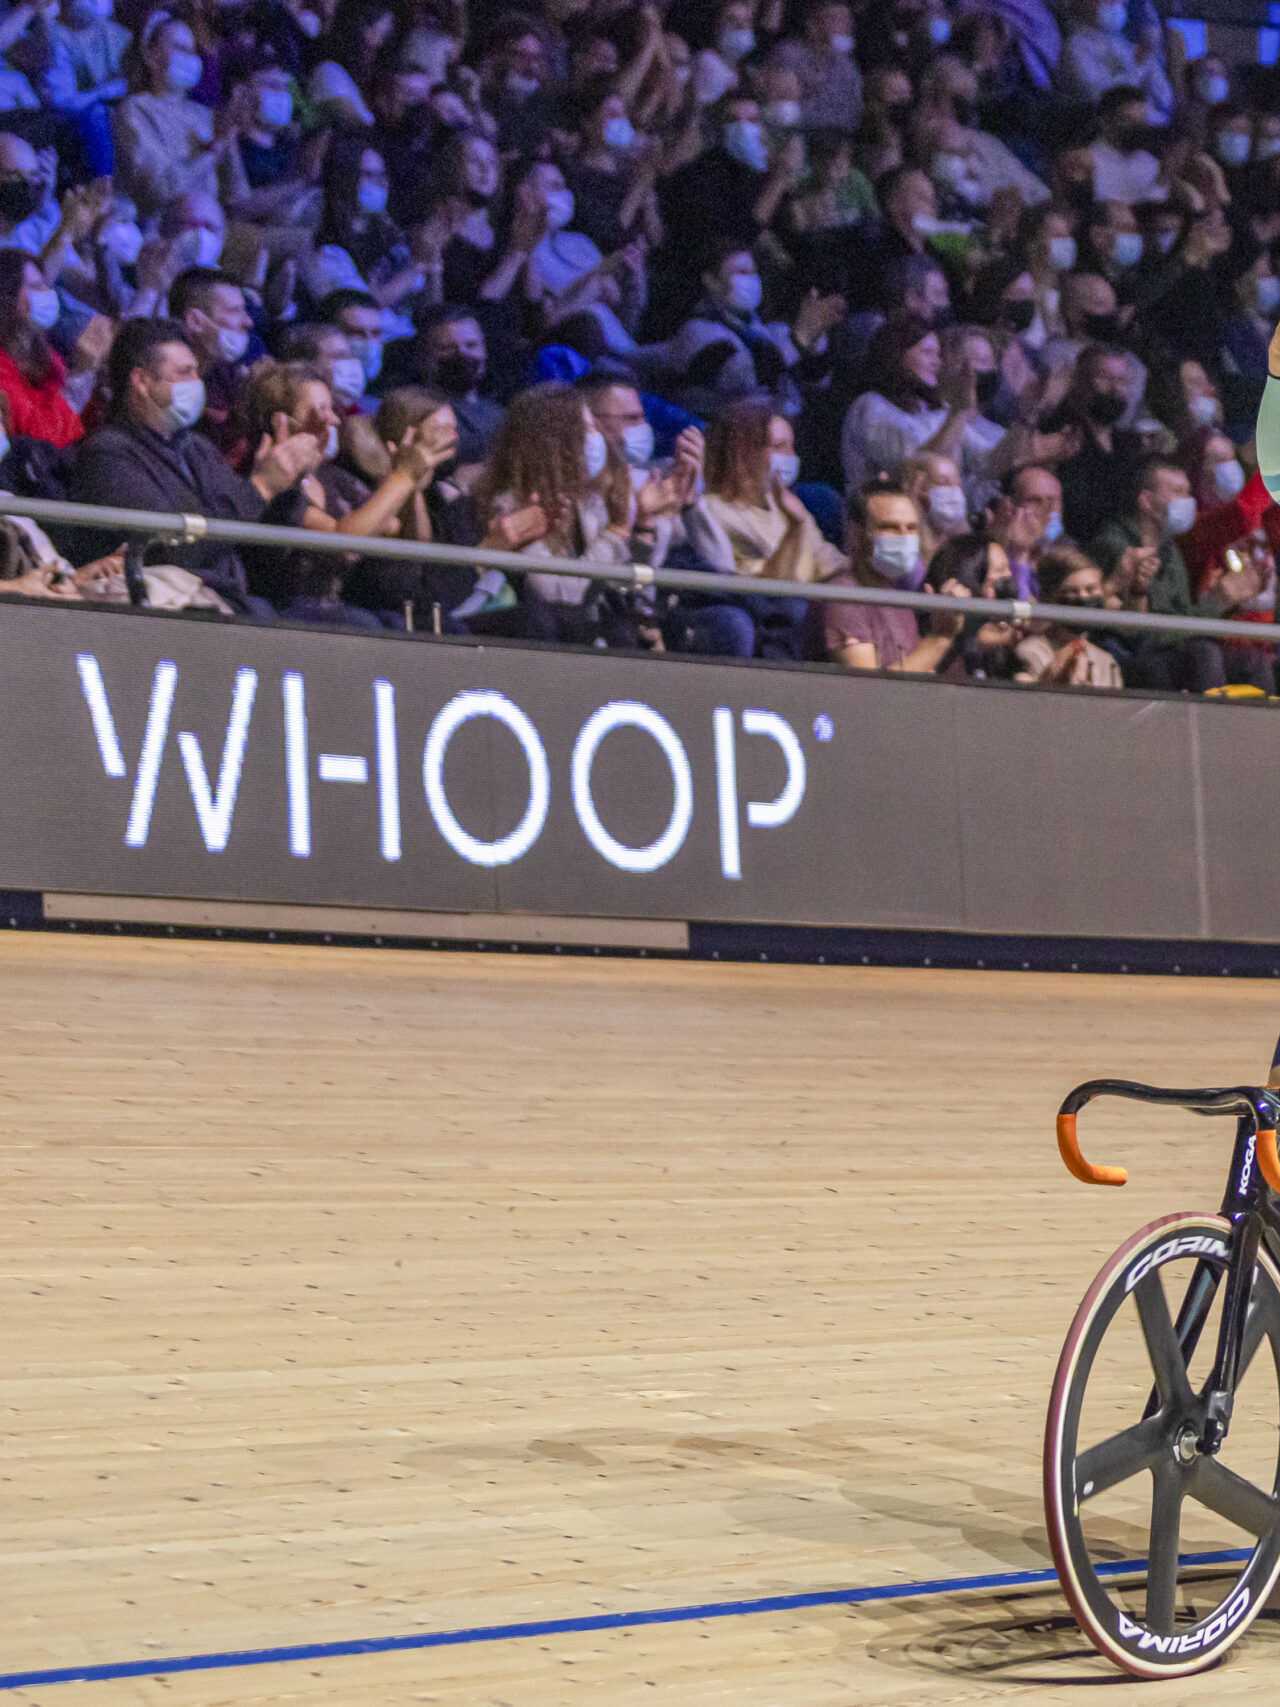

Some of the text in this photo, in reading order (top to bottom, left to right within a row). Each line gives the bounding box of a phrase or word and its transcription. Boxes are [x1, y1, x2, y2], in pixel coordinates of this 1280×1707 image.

[75, 652, 807, 879] WHOOP
[1238, 1134, 1257, 1195] KOGA
[1118, 1586, 1250, 1654] CORIMA
